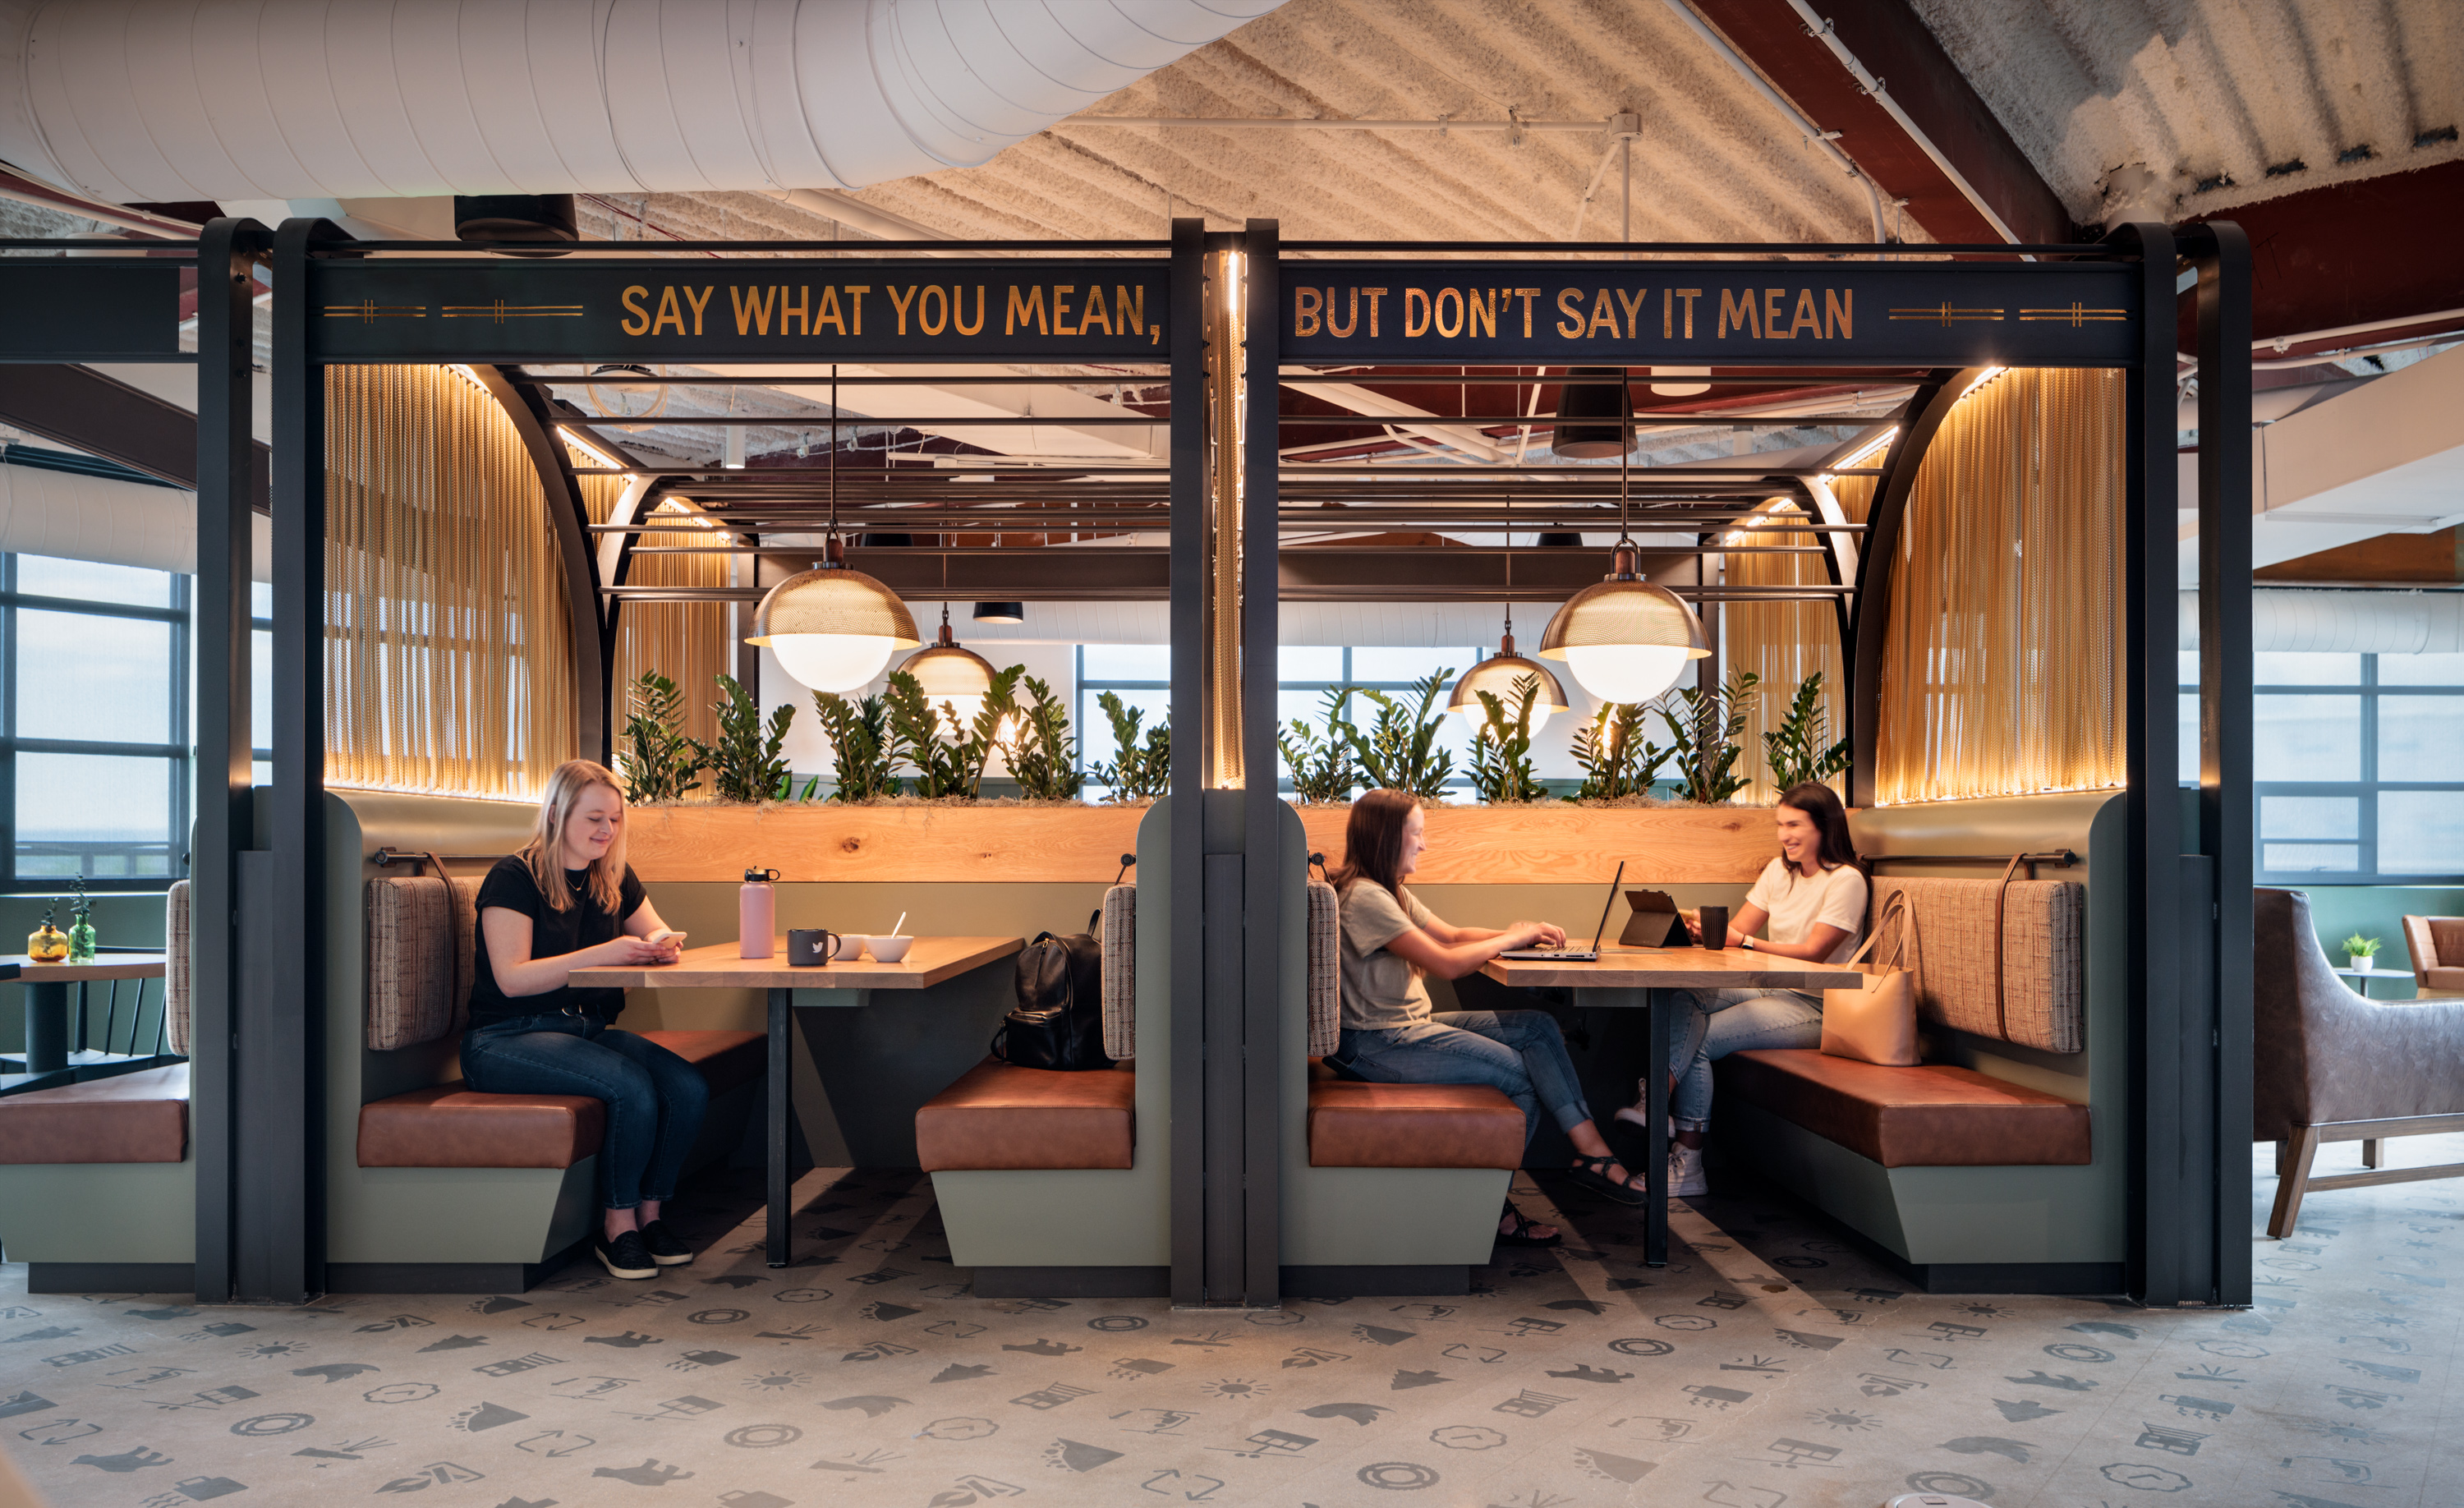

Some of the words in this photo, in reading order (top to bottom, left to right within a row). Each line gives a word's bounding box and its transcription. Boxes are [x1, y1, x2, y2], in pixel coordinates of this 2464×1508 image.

[621, 284, 715, 337] SAY
[729, 285, 871, 336] WHAT
[885, 284, 986, 337] YOU
[1004, 284, 1161, 346] MEAN,
[1294, 287, 1388, 338] BUT
[1404, 287, 1542, 338] DON'T
[1556, 287, 1648, 339] SAY
[1663, 288, 1703, 339] IT
[1717, 288, 1853, 339] MEAN
